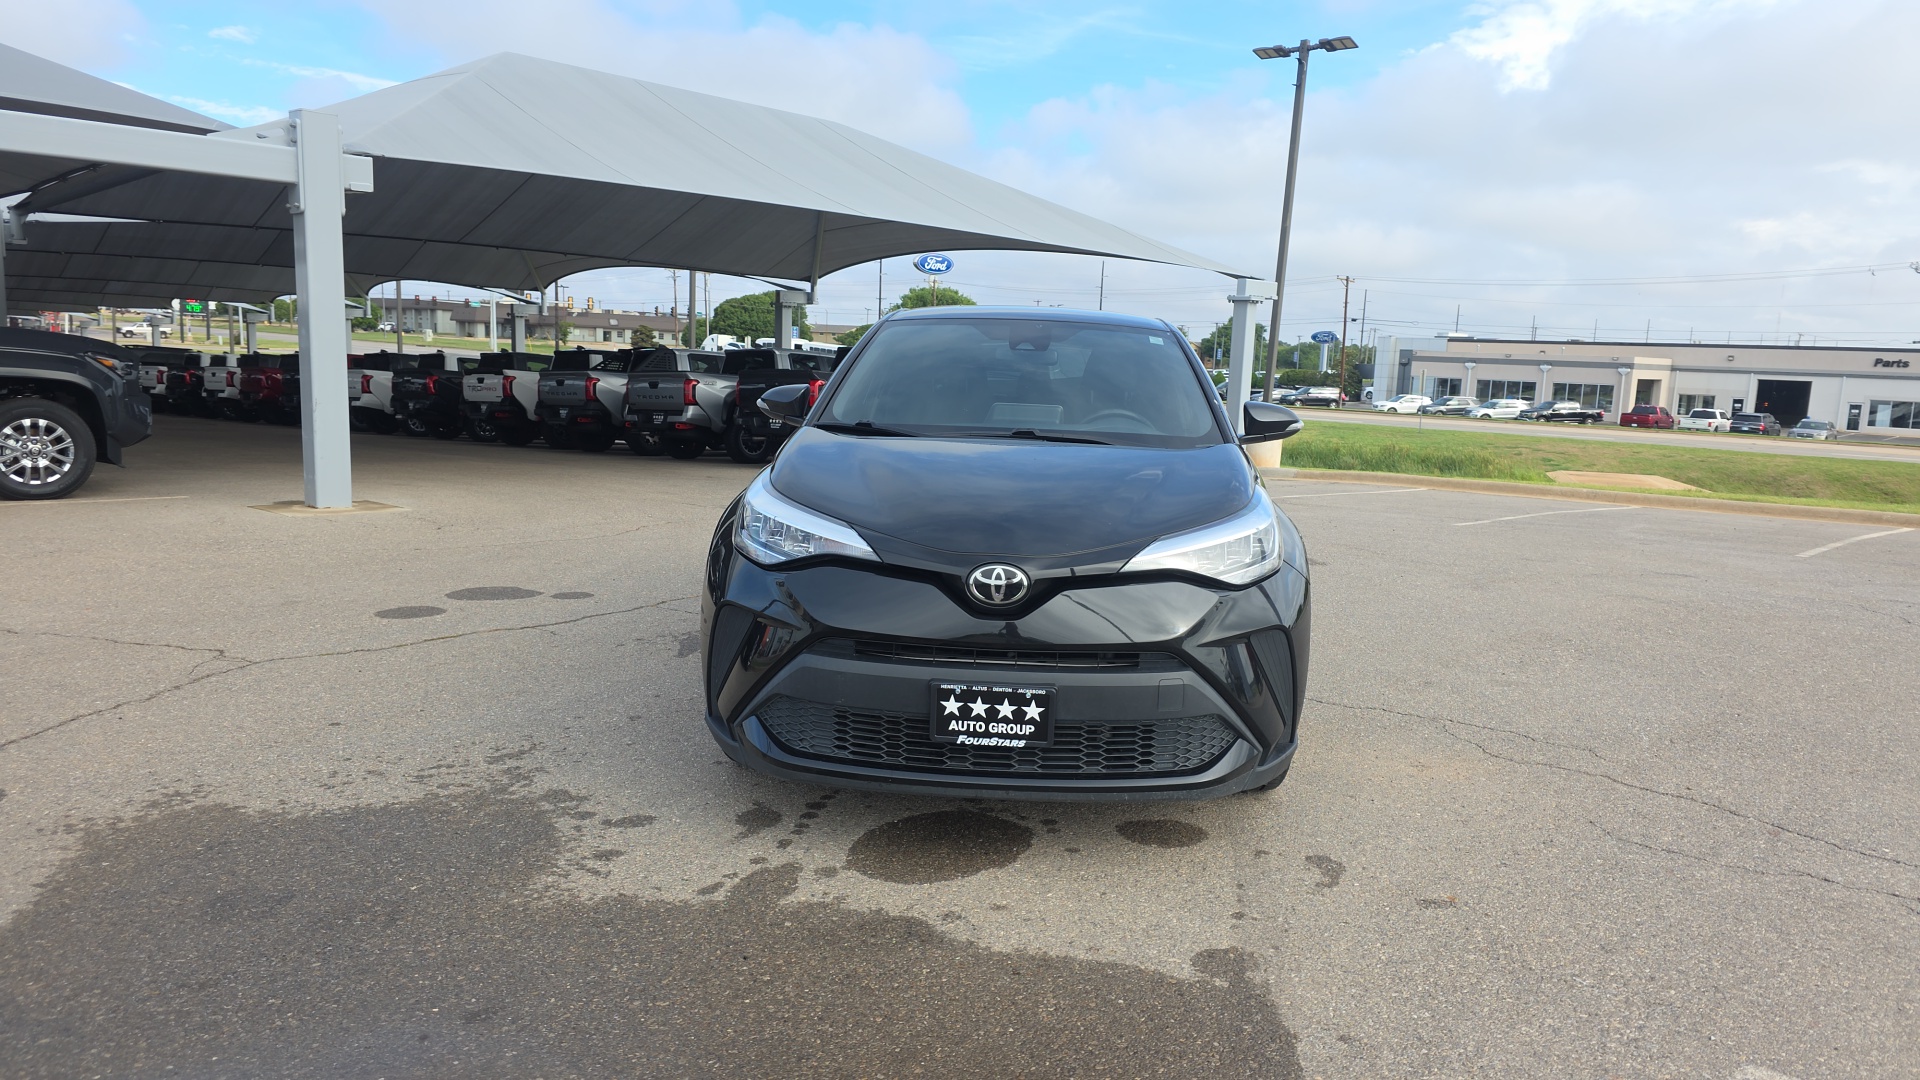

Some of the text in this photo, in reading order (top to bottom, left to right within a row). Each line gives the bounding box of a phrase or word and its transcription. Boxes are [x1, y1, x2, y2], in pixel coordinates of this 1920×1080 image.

[924, 256, 948, 270] Ford
[1873, 357, 1910, 368] Parts
[948, 720, 1035, 735] AUTO GROUP
